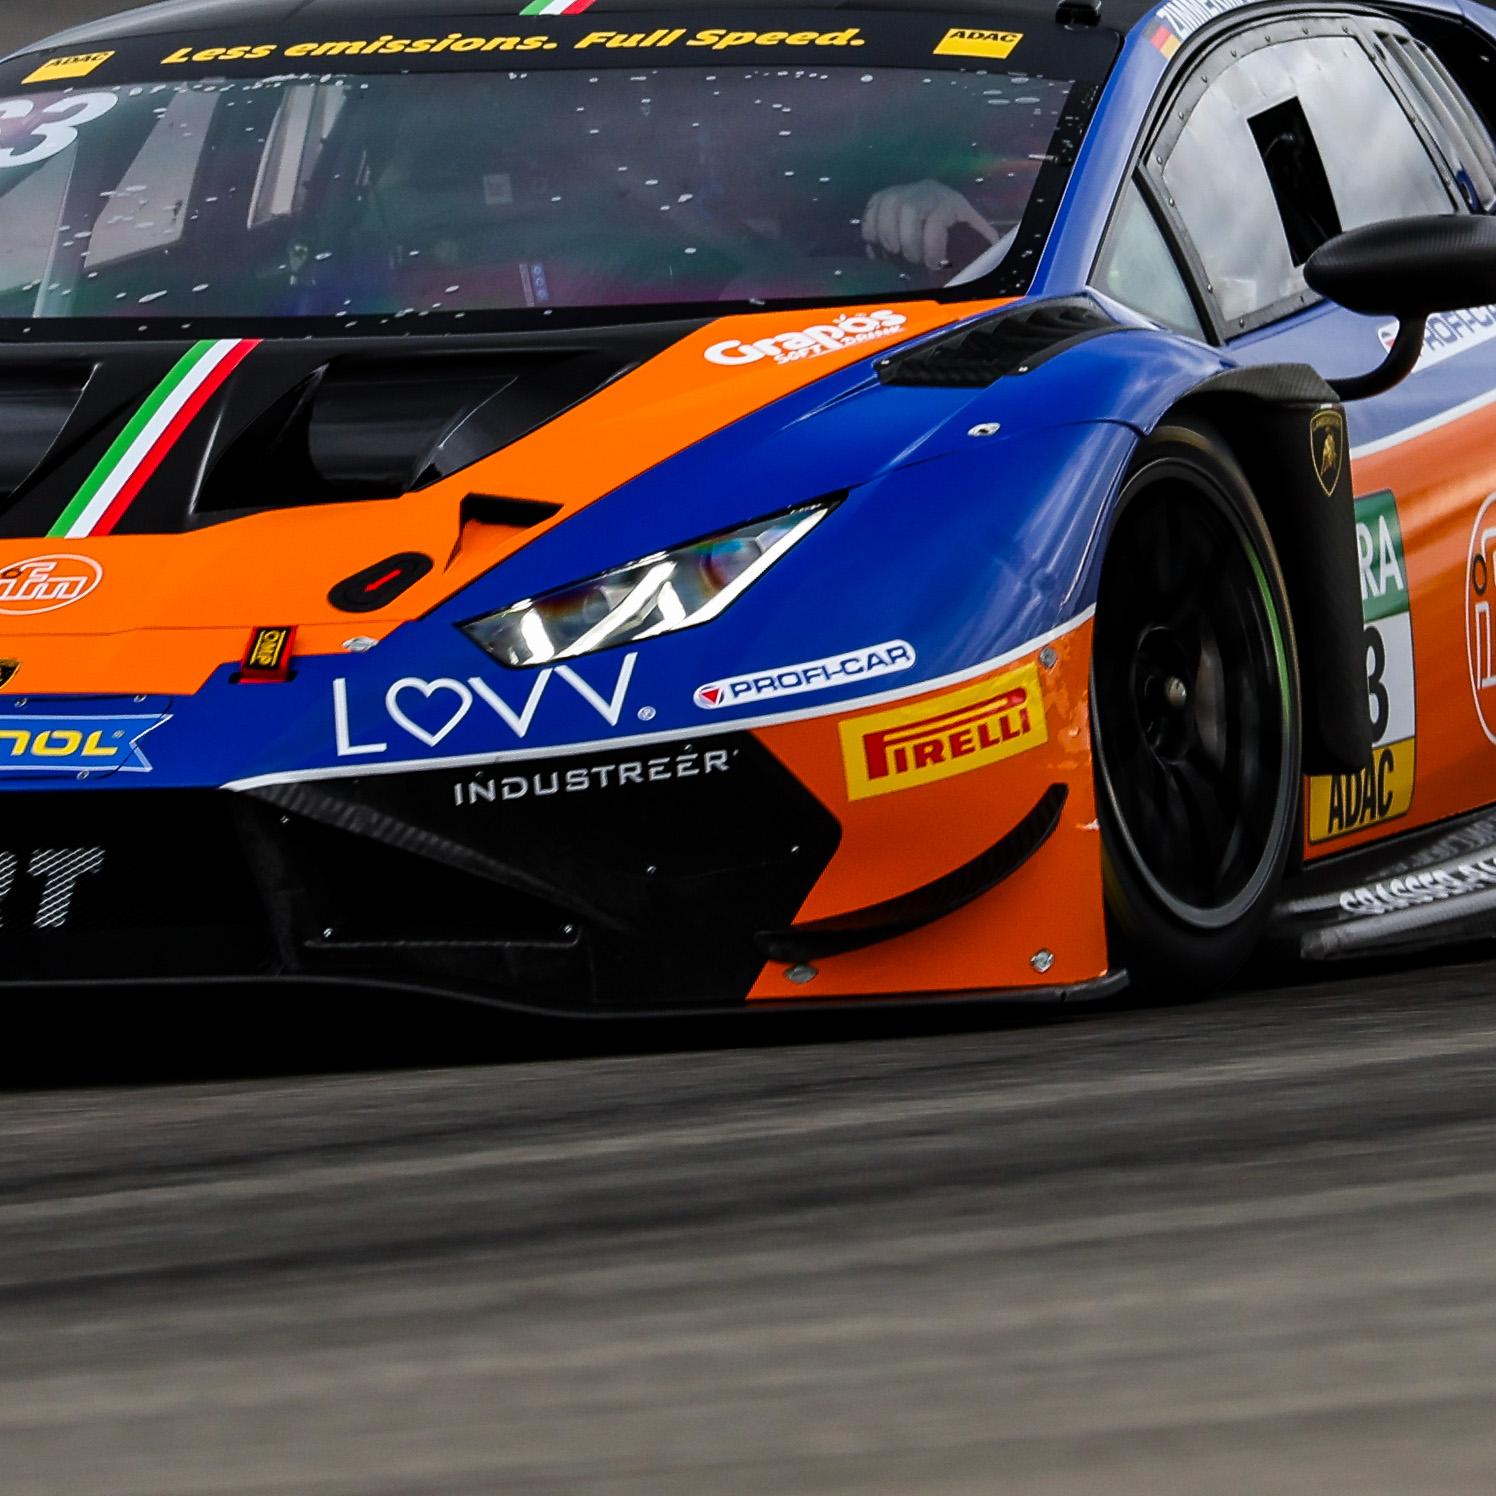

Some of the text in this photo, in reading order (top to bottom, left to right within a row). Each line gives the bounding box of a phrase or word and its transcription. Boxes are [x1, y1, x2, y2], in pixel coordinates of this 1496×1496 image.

[160, 27, 866, 65] Less emissions. Full Speed.
[949, 29, 1021, 45] ADAC
[773, 344, 825, 365] SOFT
[729, 645, 912, 701] PROFI-CAR
[1363, 624, 1390, 745] 3
[863, 687, 1032, 780] PIRELLI
[454, 744, 733, 807] INDUSTREER
[1328, 747, 1394, 835] ADAC
